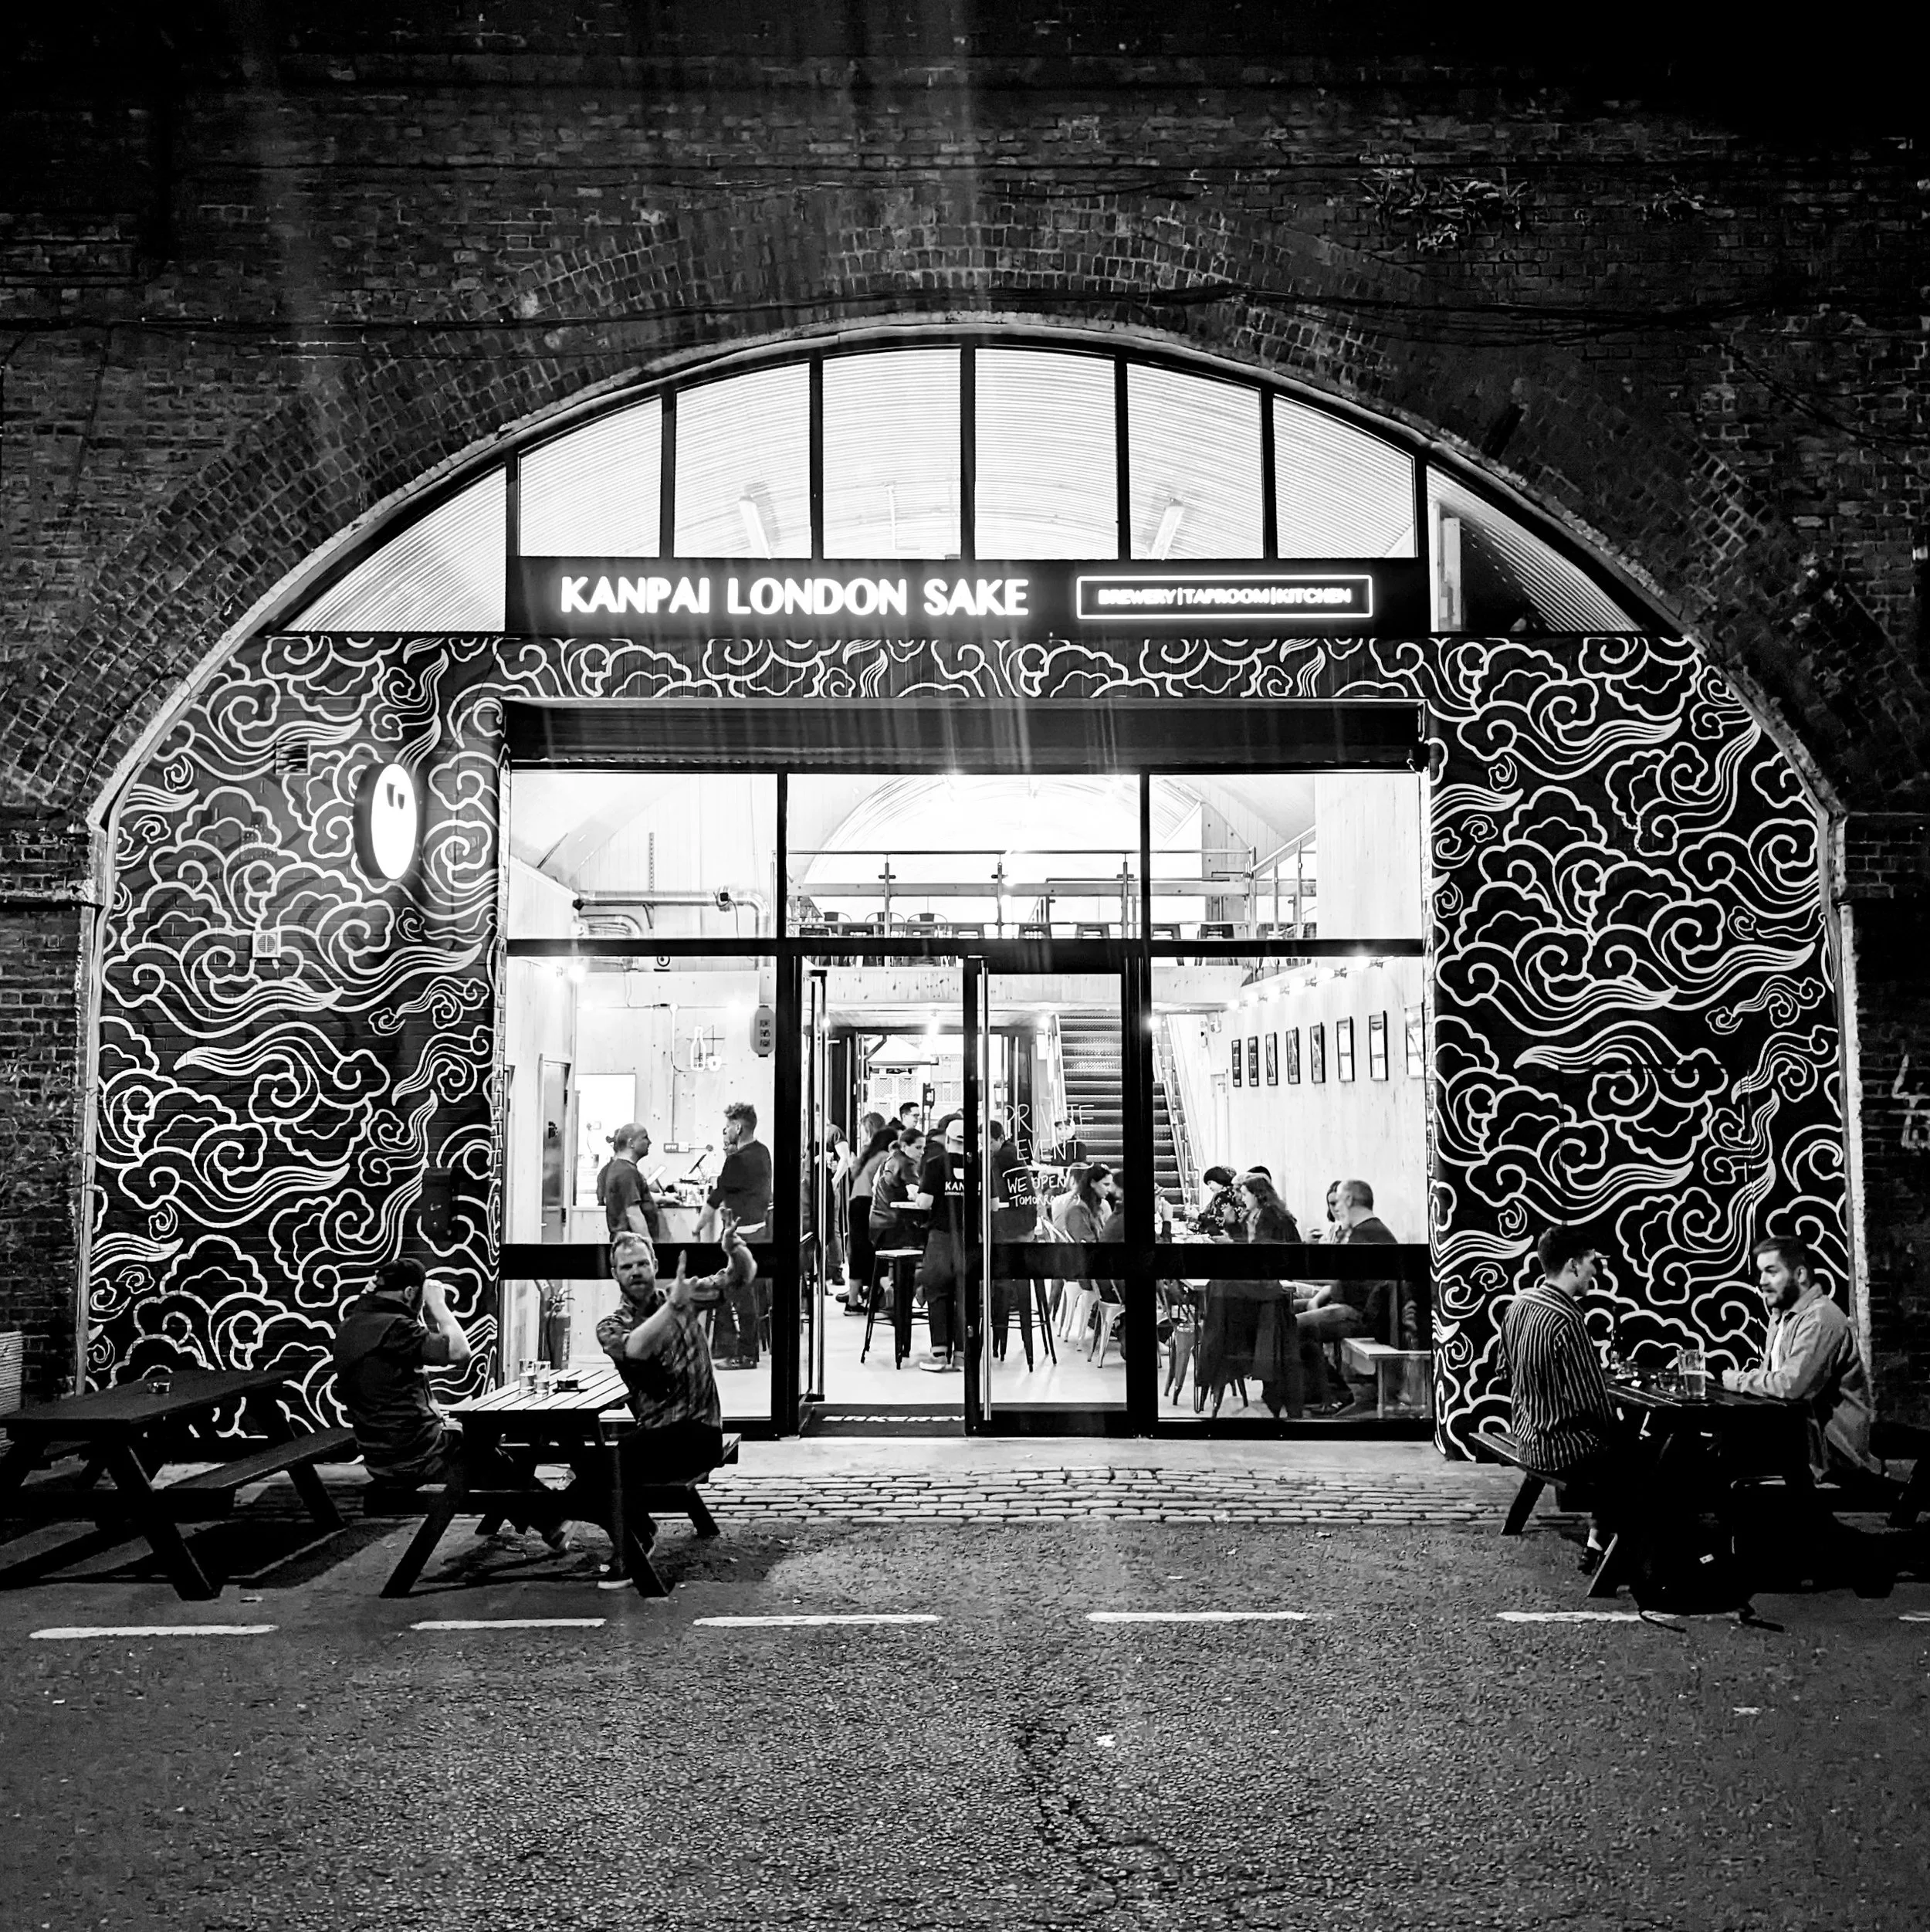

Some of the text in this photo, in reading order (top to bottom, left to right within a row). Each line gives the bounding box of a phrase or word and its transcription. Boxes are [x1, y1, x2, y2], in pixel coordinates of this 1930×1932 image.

[560, 576, 1029, 616] KANPAI LONDON SAKE
[1004, 1103, 1095, 1133] PRIVTE
[1017, 1139, 1082, 1161] EVENT
[945, 1181, 981, 1191] KANI
[1007, 1174, 1067, 1194] WE OPEN
[1009, 1194, 1068, 1208] TOMORROW
